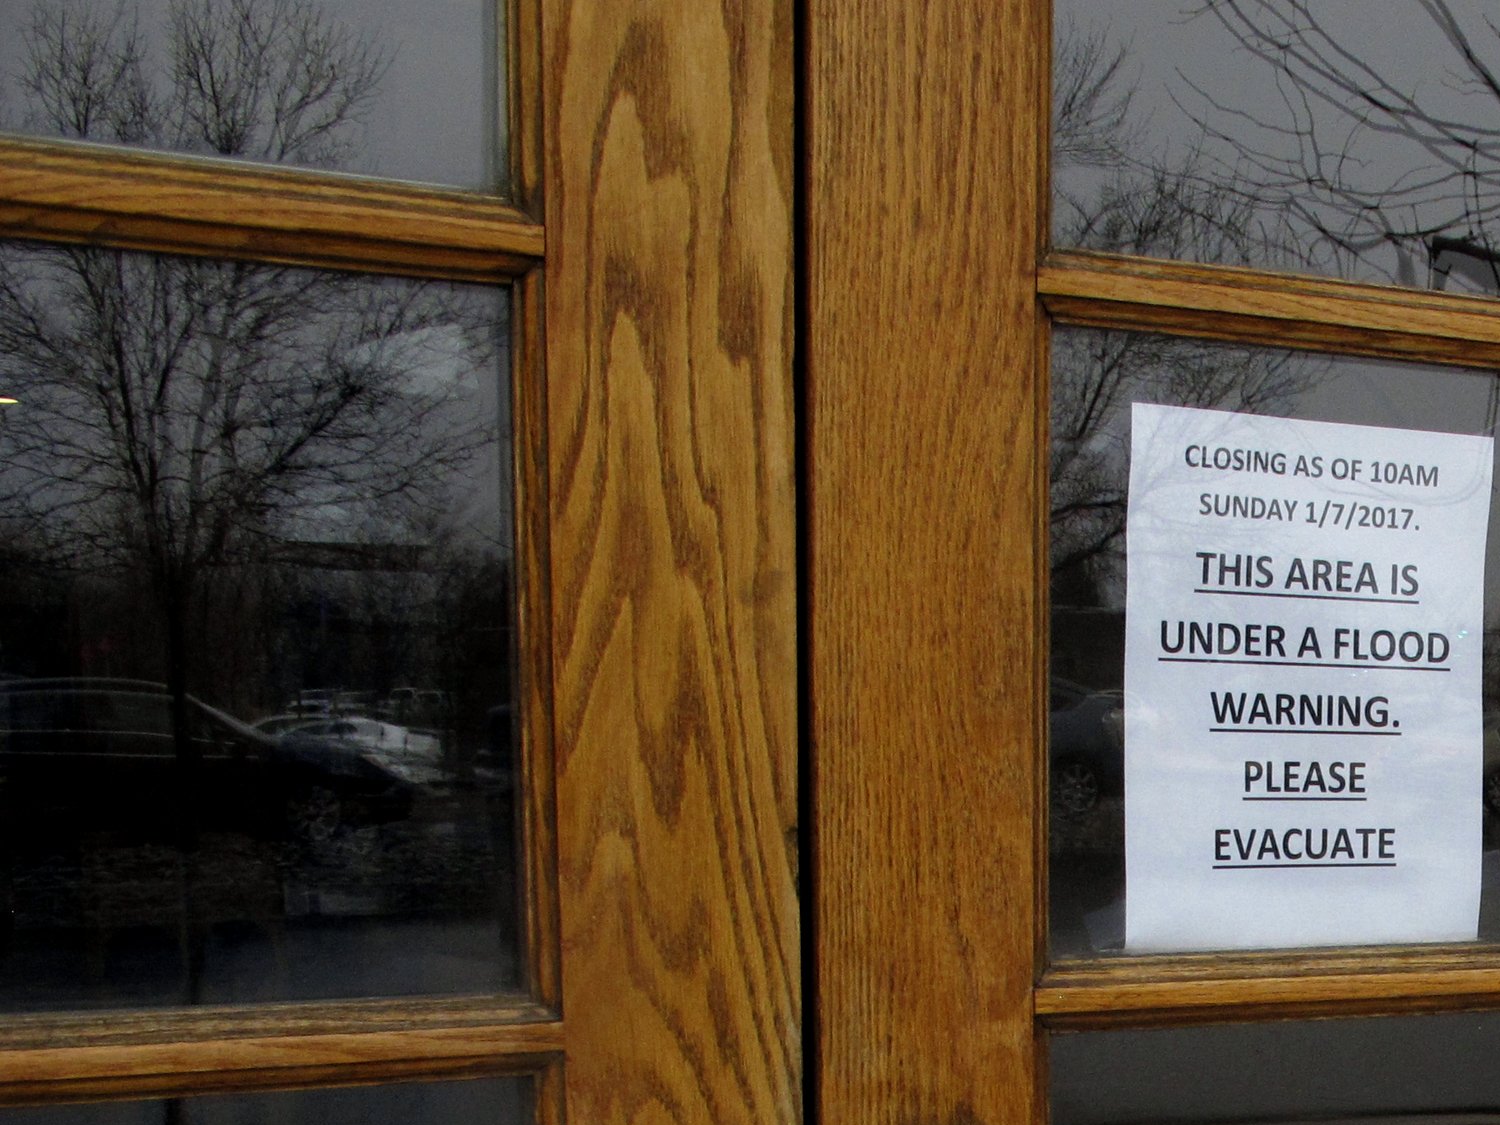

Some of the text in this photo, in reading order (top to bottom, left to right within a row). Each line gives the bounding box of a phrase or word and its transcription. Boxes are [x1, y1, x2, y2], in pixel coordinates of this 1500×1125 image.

[1184, 444, 1440, 488] CLOSING AS OF 10AM
[1199, 493, 1421, 531] SUNDAY 1/7/2017.
[1196, 551, 1420, 597] THIS AREA IS
[1160, 620, 1451, 664] UNDER A FLOOD
[1210, 691, 1401, 730] WARNING.
[1243, 760, 1367, 794] PLEASE
[1213, 827, 1396, 862] EVACUATE
